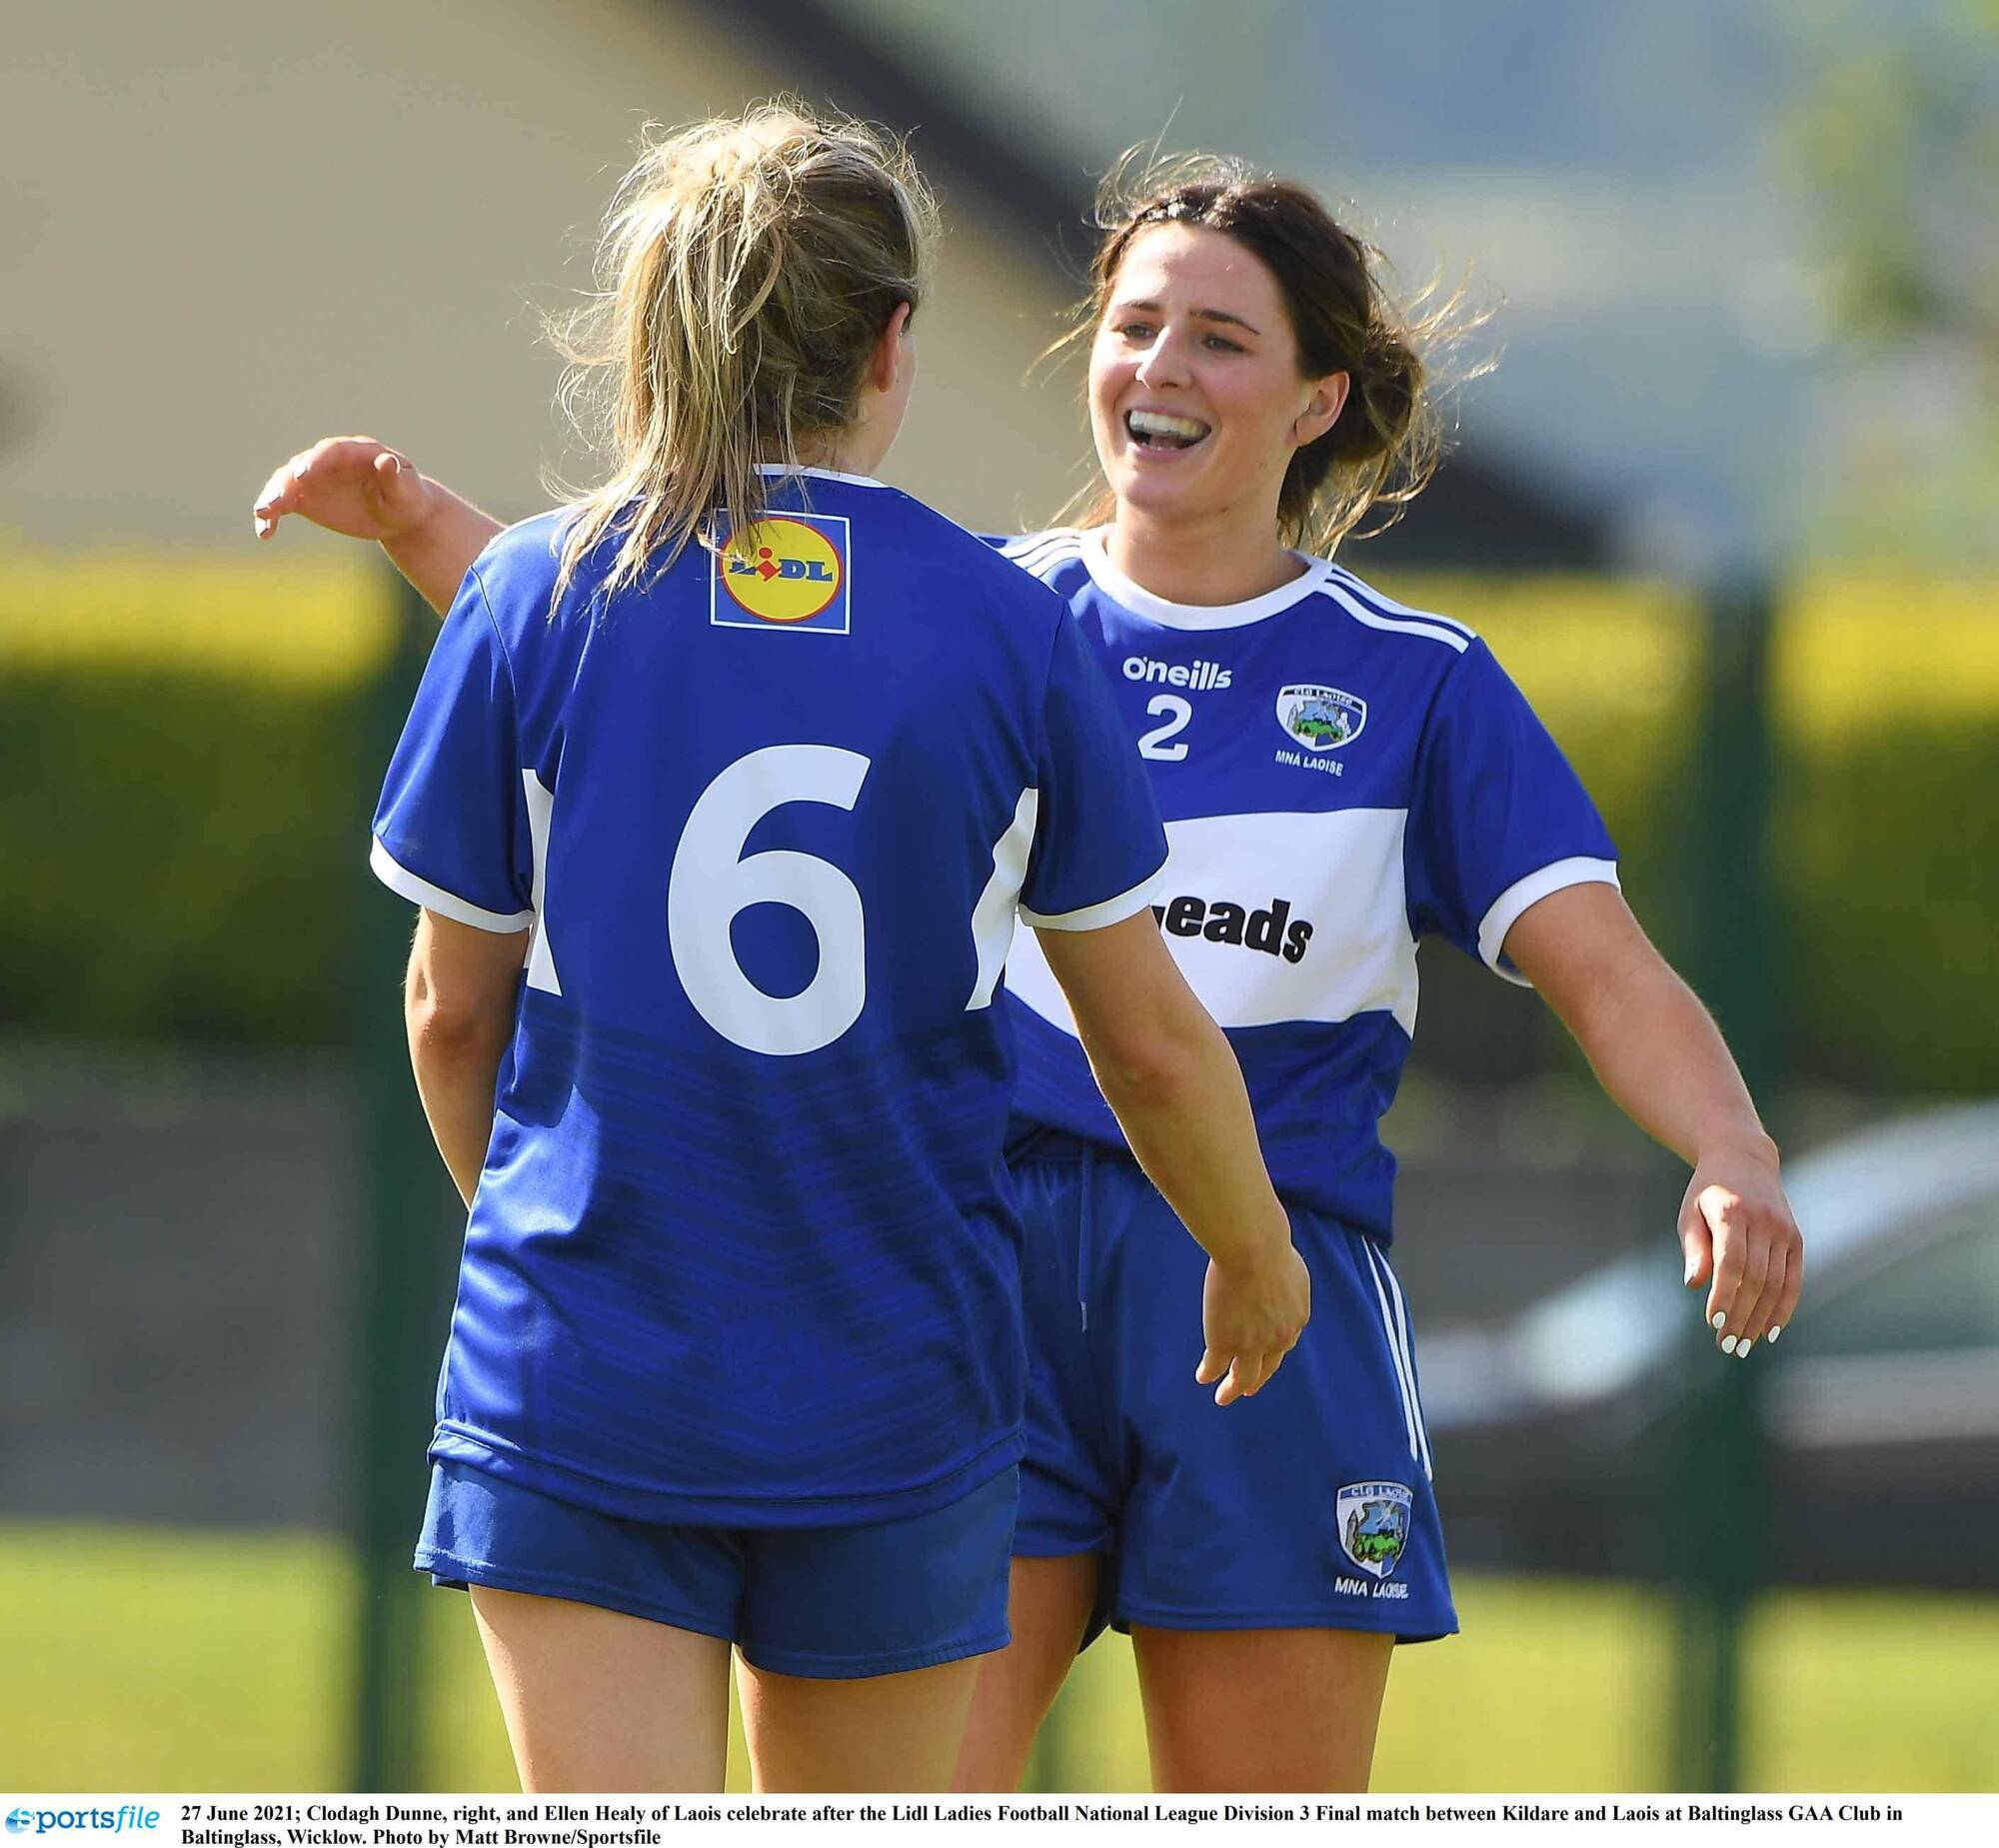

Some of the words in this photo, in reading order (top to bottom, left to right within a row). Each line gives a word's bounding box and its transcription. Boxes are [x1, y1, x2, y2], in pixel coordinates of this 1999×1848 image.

[1136, 694, 1192, 762] 2
[1303, 756, 1344, 778] LAOISE
[668, 744, 872, 1056] 6
[1151, 896, 1314, 964] eads
